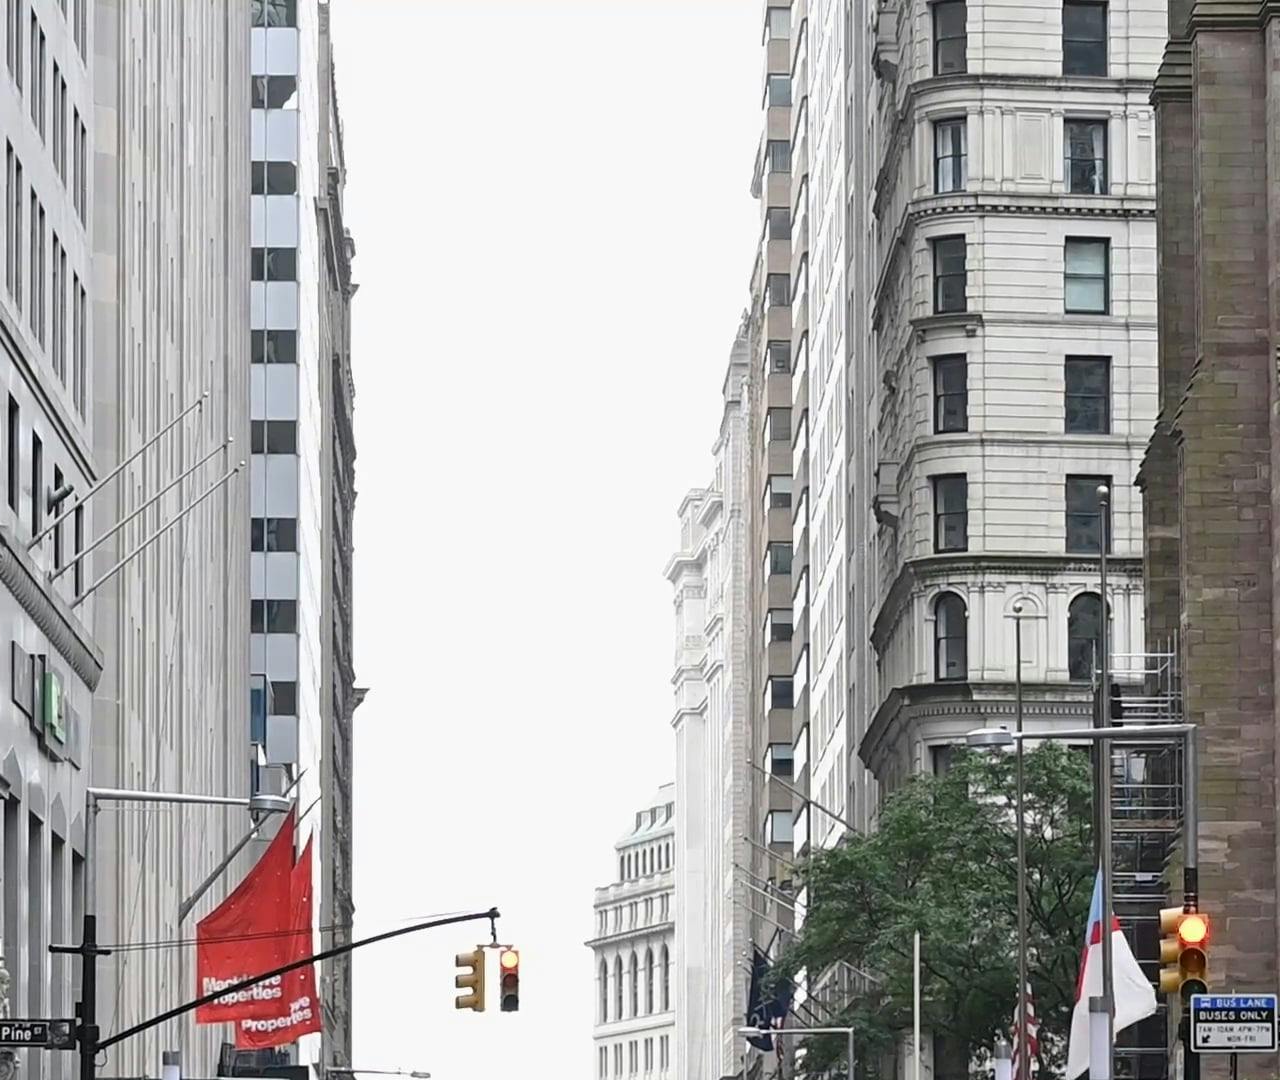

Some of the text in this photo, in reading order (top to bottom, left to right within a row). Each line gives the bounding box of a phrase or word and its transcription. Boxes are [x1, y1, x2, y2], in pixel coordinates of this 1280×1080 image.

[1216, 998, 1268, 1008] BUS LANE
[1199, 1011, 1268, 1020] BUSES ONLY
[2, 1026, 32, 1041] Pine
